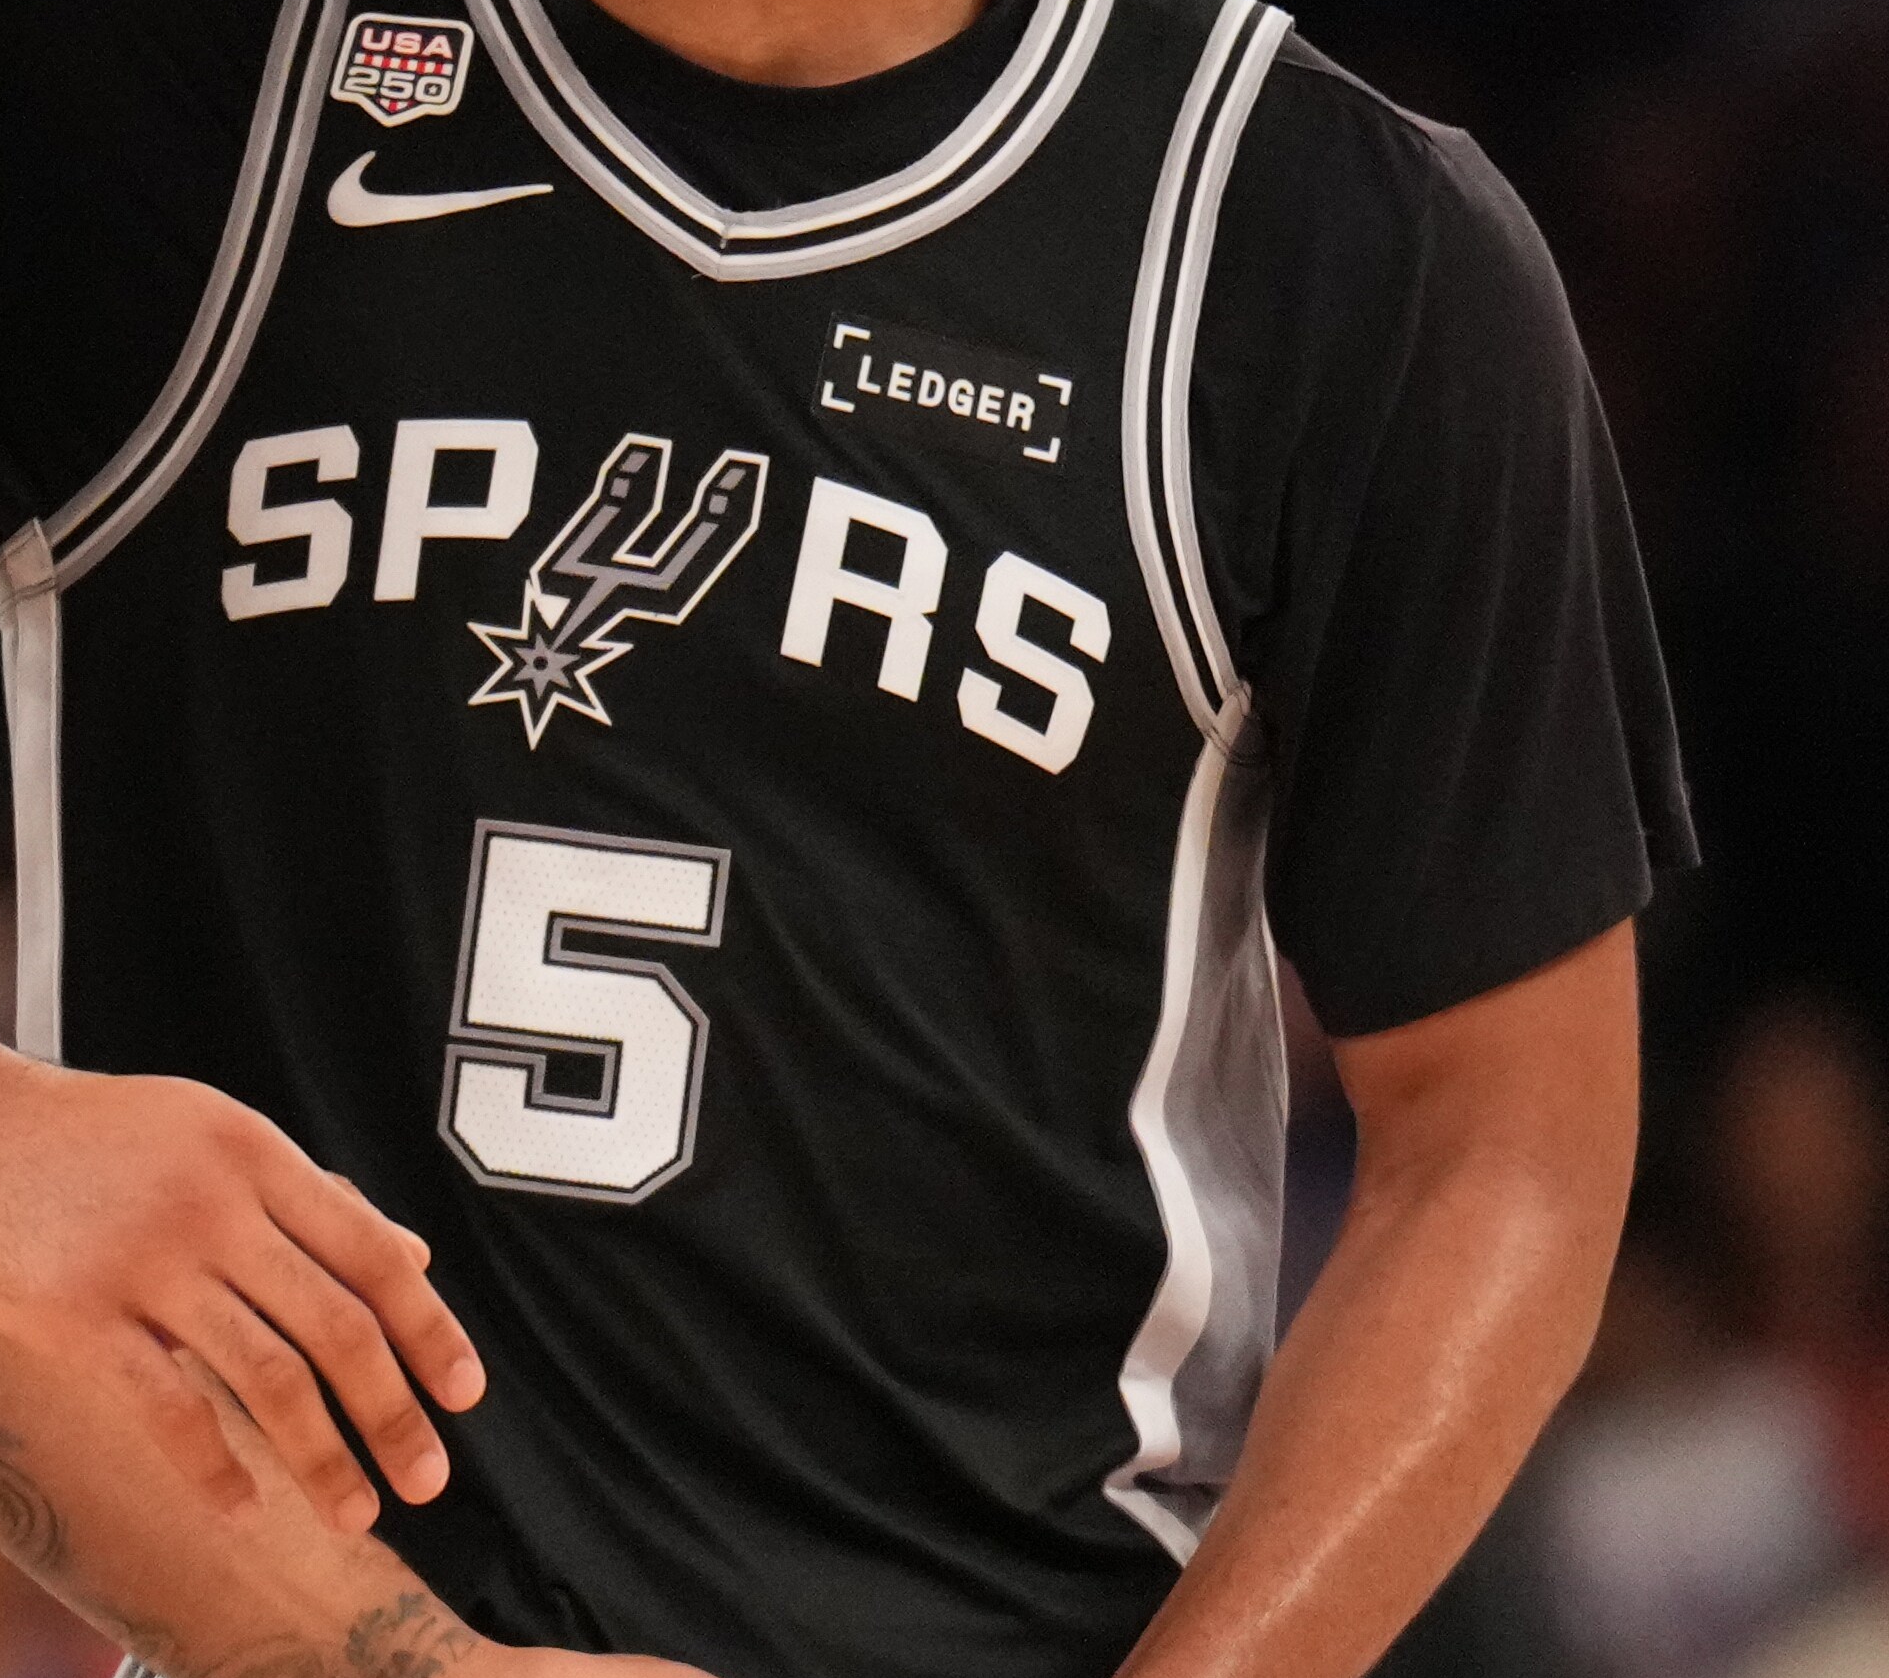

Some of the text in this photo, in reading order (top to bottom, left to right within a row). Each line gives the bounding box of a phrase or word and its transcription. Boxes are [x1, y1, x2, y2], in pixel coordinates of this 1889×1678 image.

[361, 27, 454, 60] USA
[343, 66, 451, 104] 250
[856, 354, 1036, 432] LEDGER
[221, 418, 1112, 775] SPURS
[437, 818, 732, 1206] 5
